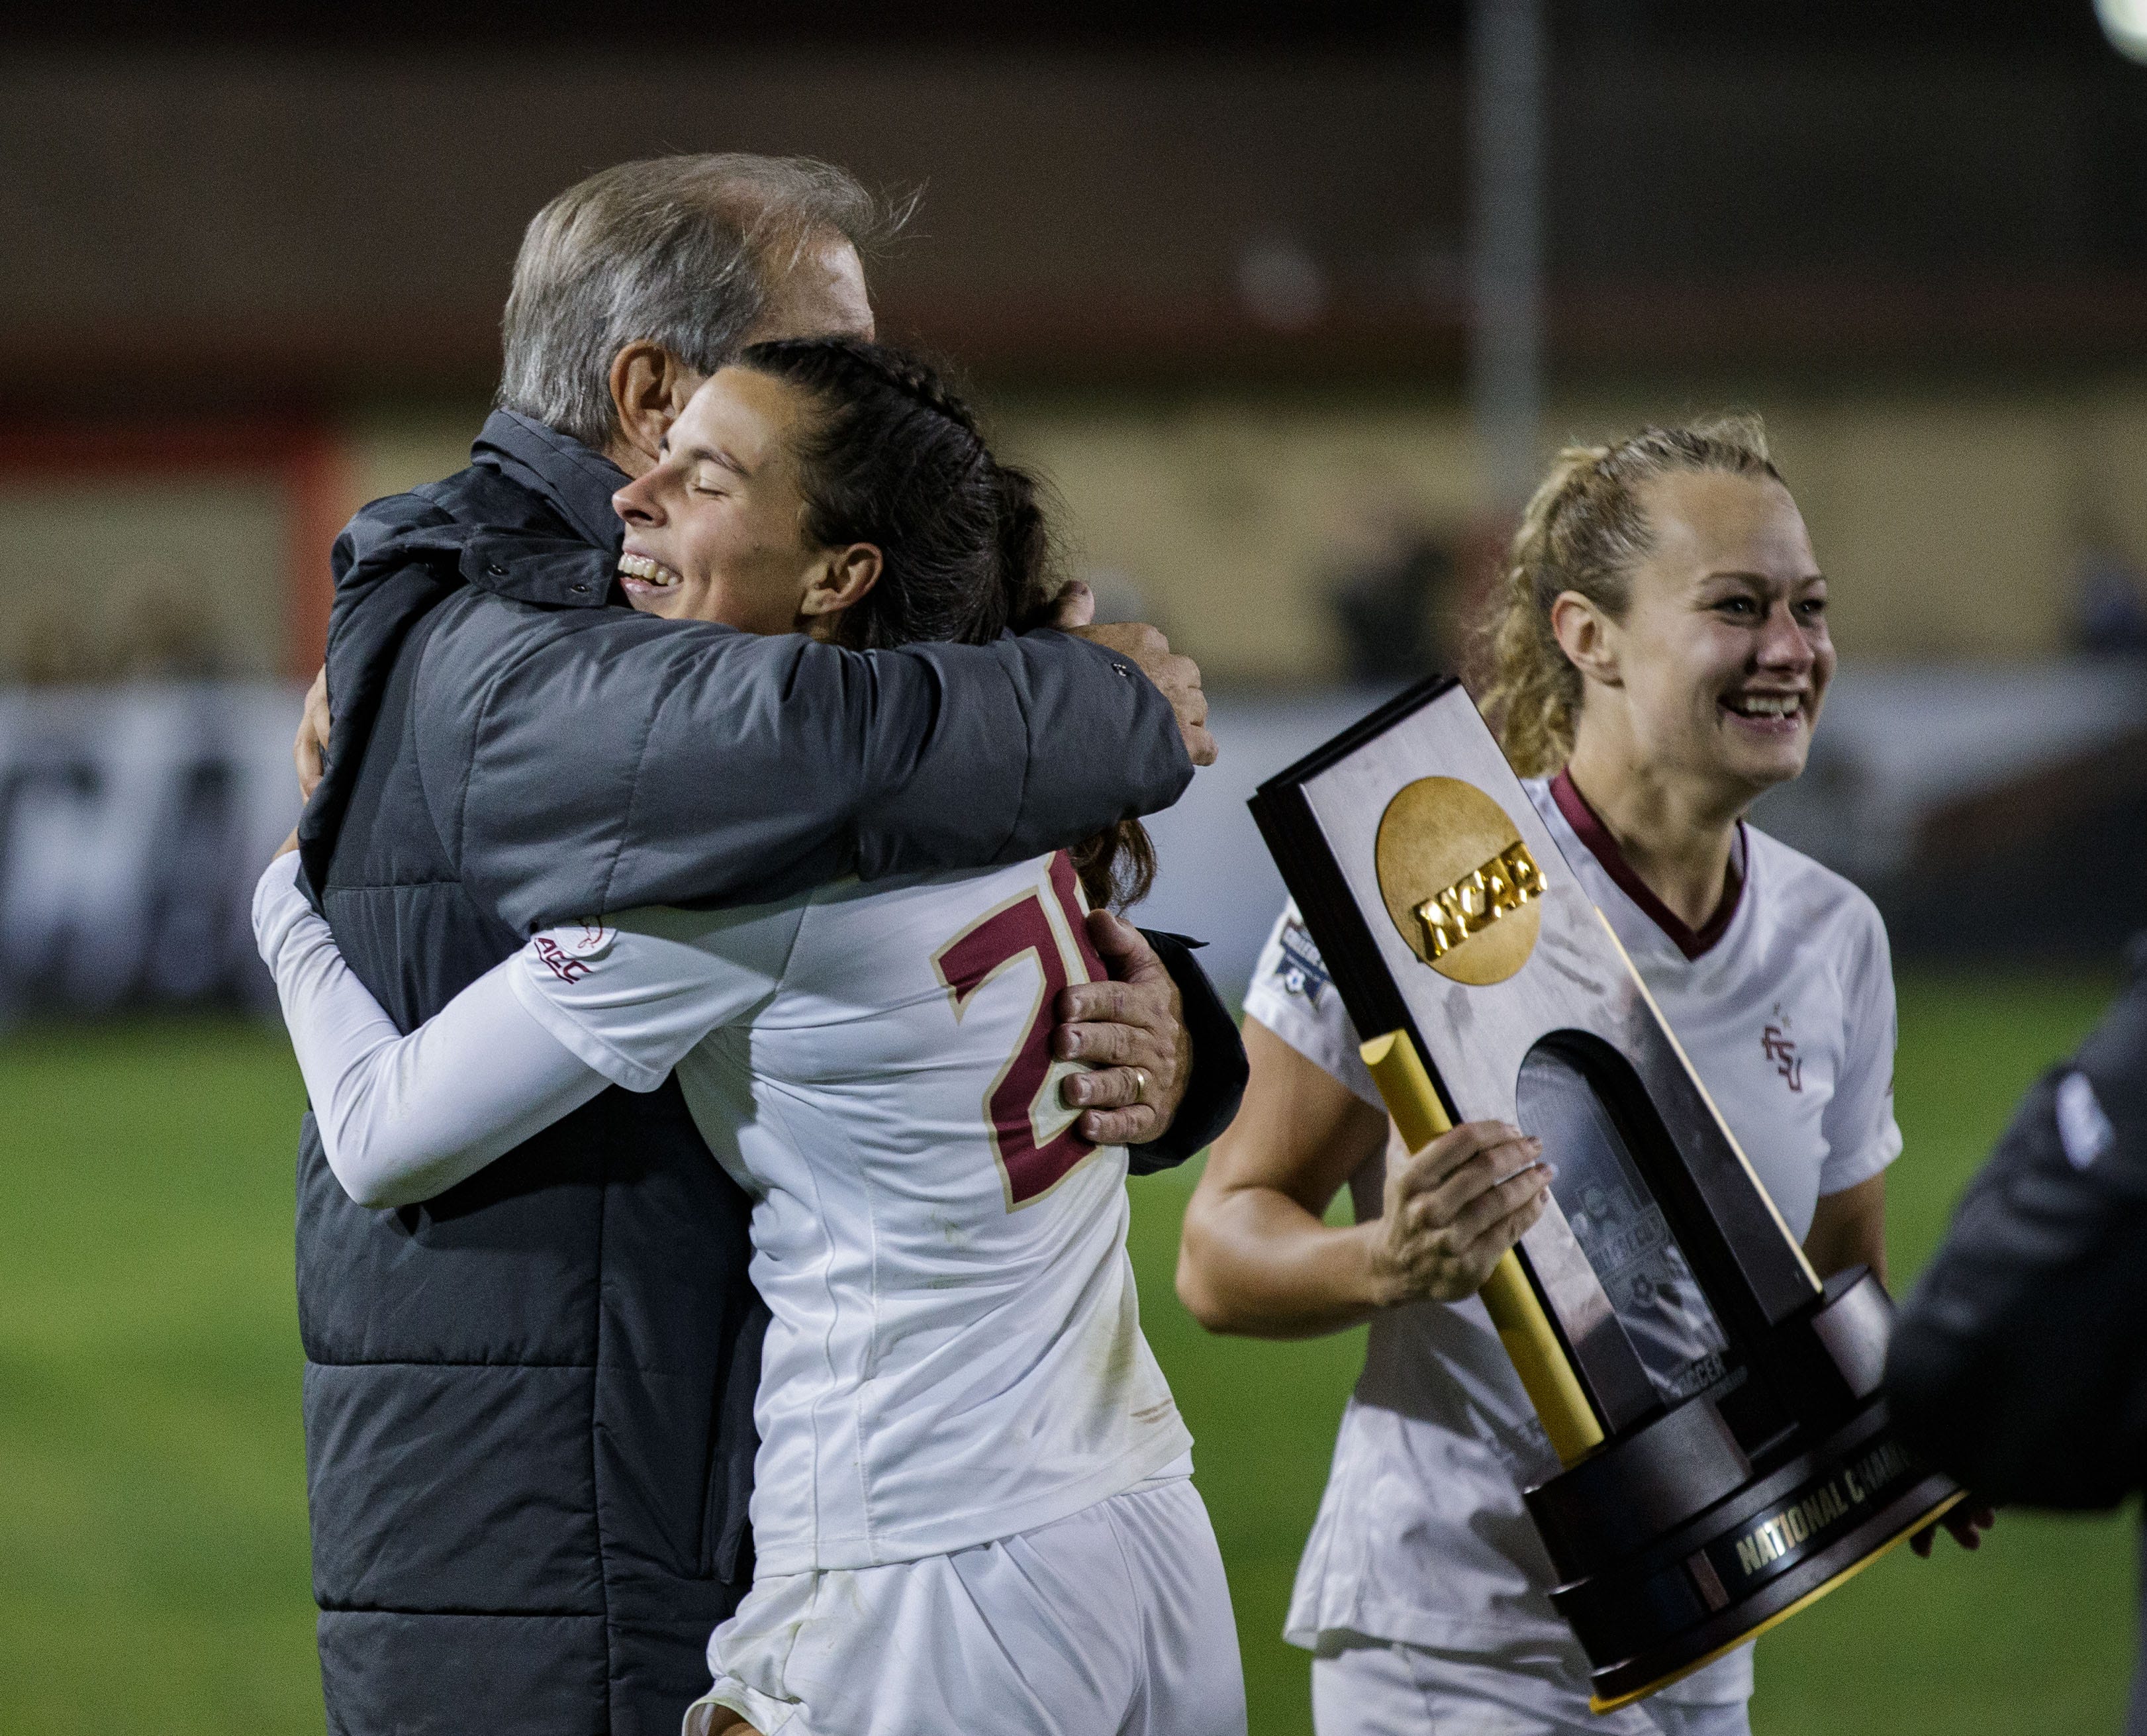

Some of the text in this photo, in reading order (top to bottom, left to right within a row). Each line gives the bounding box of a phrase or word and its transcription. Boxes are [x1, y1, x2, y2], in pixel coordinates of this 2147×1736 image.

[1413, 841, 1548, 961] NCAA
[535, 937, 593, 984] ACC
[1762, 1026, 1802, 1092] FSU
[1735, 1480, 1849, 1576] NATIONAL
